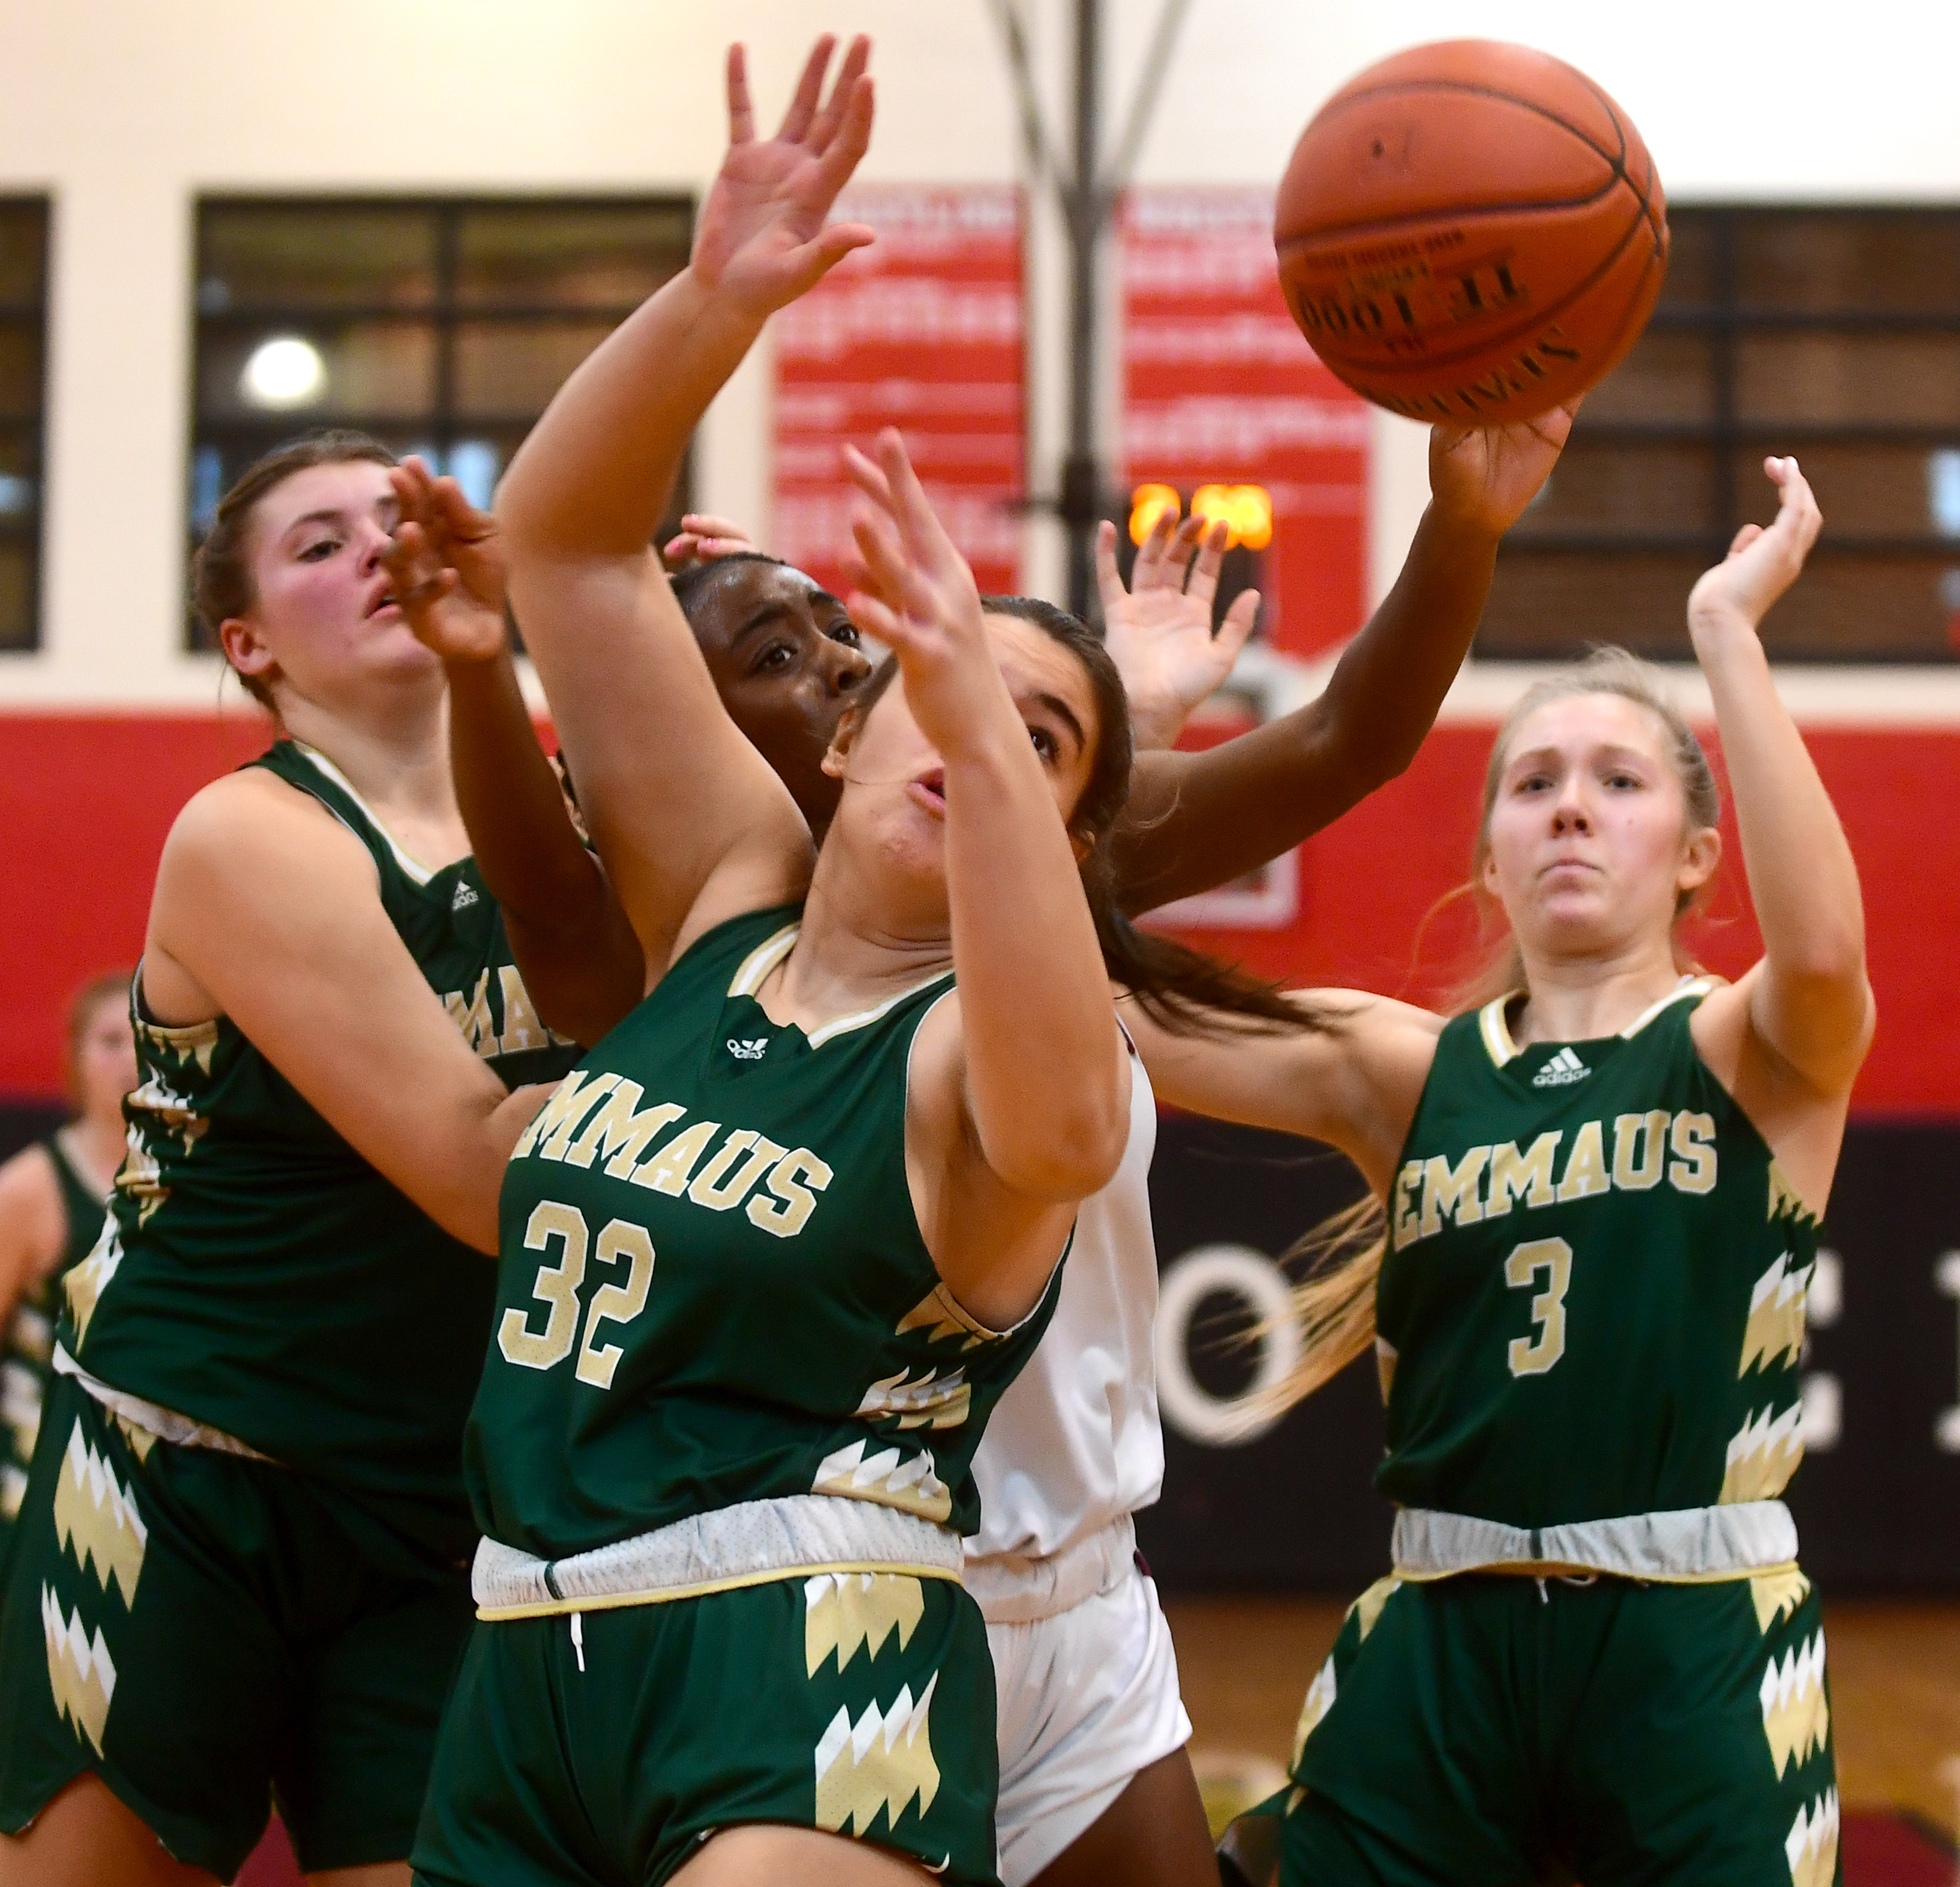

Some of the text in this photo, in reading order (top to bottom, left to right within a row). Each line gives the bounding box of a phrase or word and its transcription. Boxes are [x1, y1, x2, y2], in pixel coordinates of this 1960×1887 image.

[509, 1069, 834, 1239] MMAUS
[1394, 1109, 1718, 1252] EMMAUS
[497, 1200, 656, 1390] 32
[1504, 1236, 1573, 1378] 3
